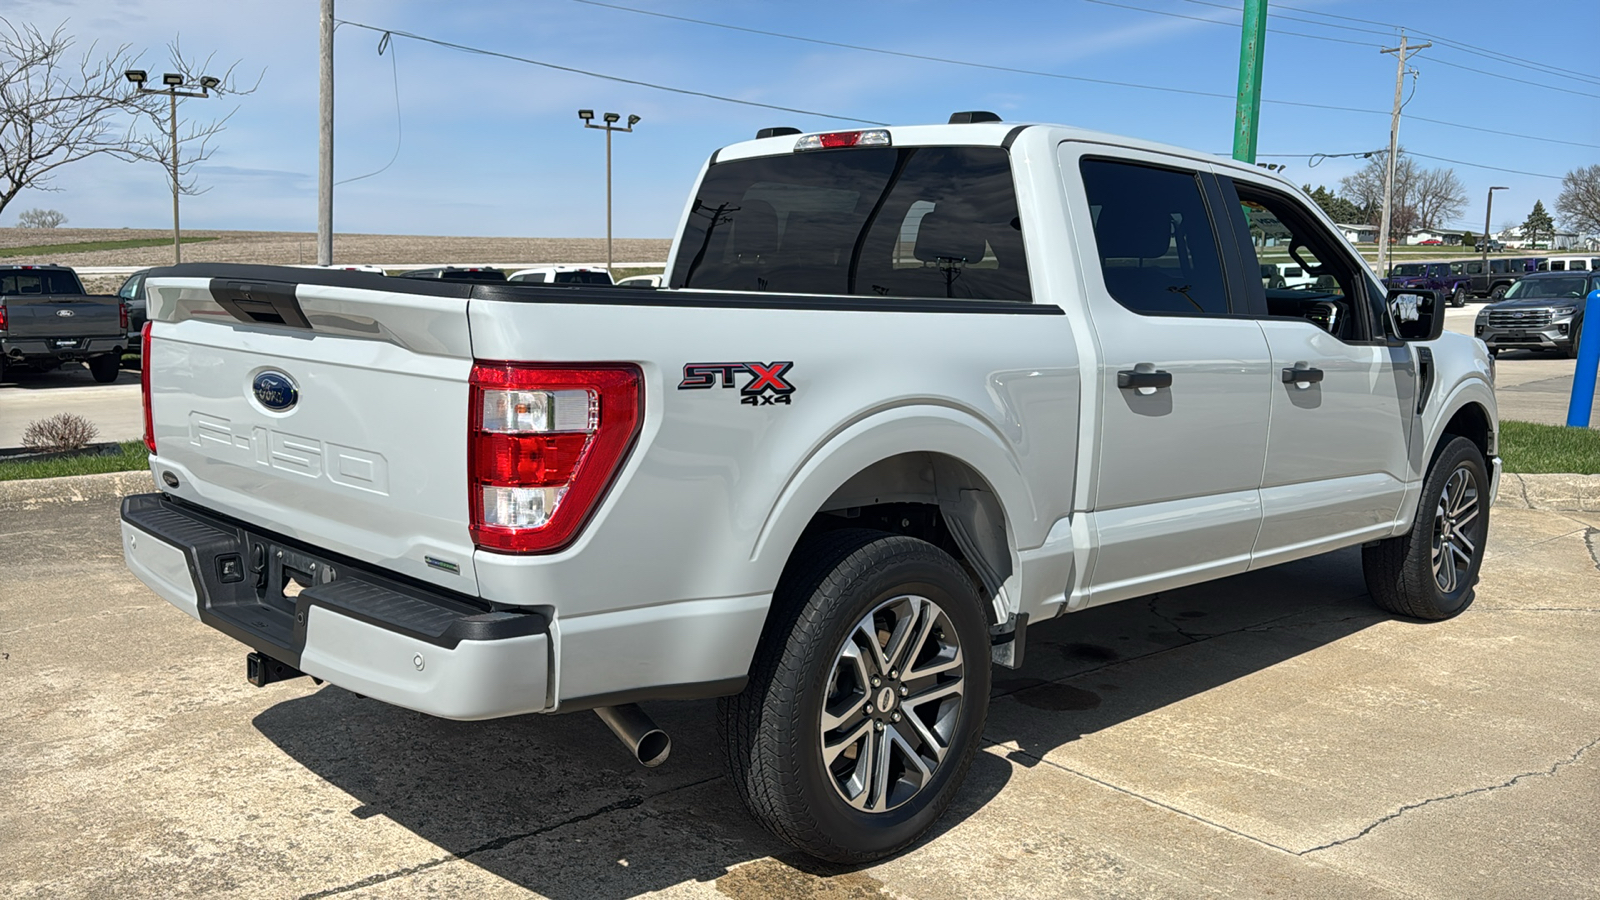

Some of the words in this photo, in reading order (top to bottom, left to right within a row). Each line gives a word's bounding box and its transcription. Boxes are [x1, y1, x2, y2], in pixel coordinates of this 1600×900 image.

[258, 378, 284, 404] Ford
[678, 361, 796, 396] STX
[189, 410, 389, 497] F-150
